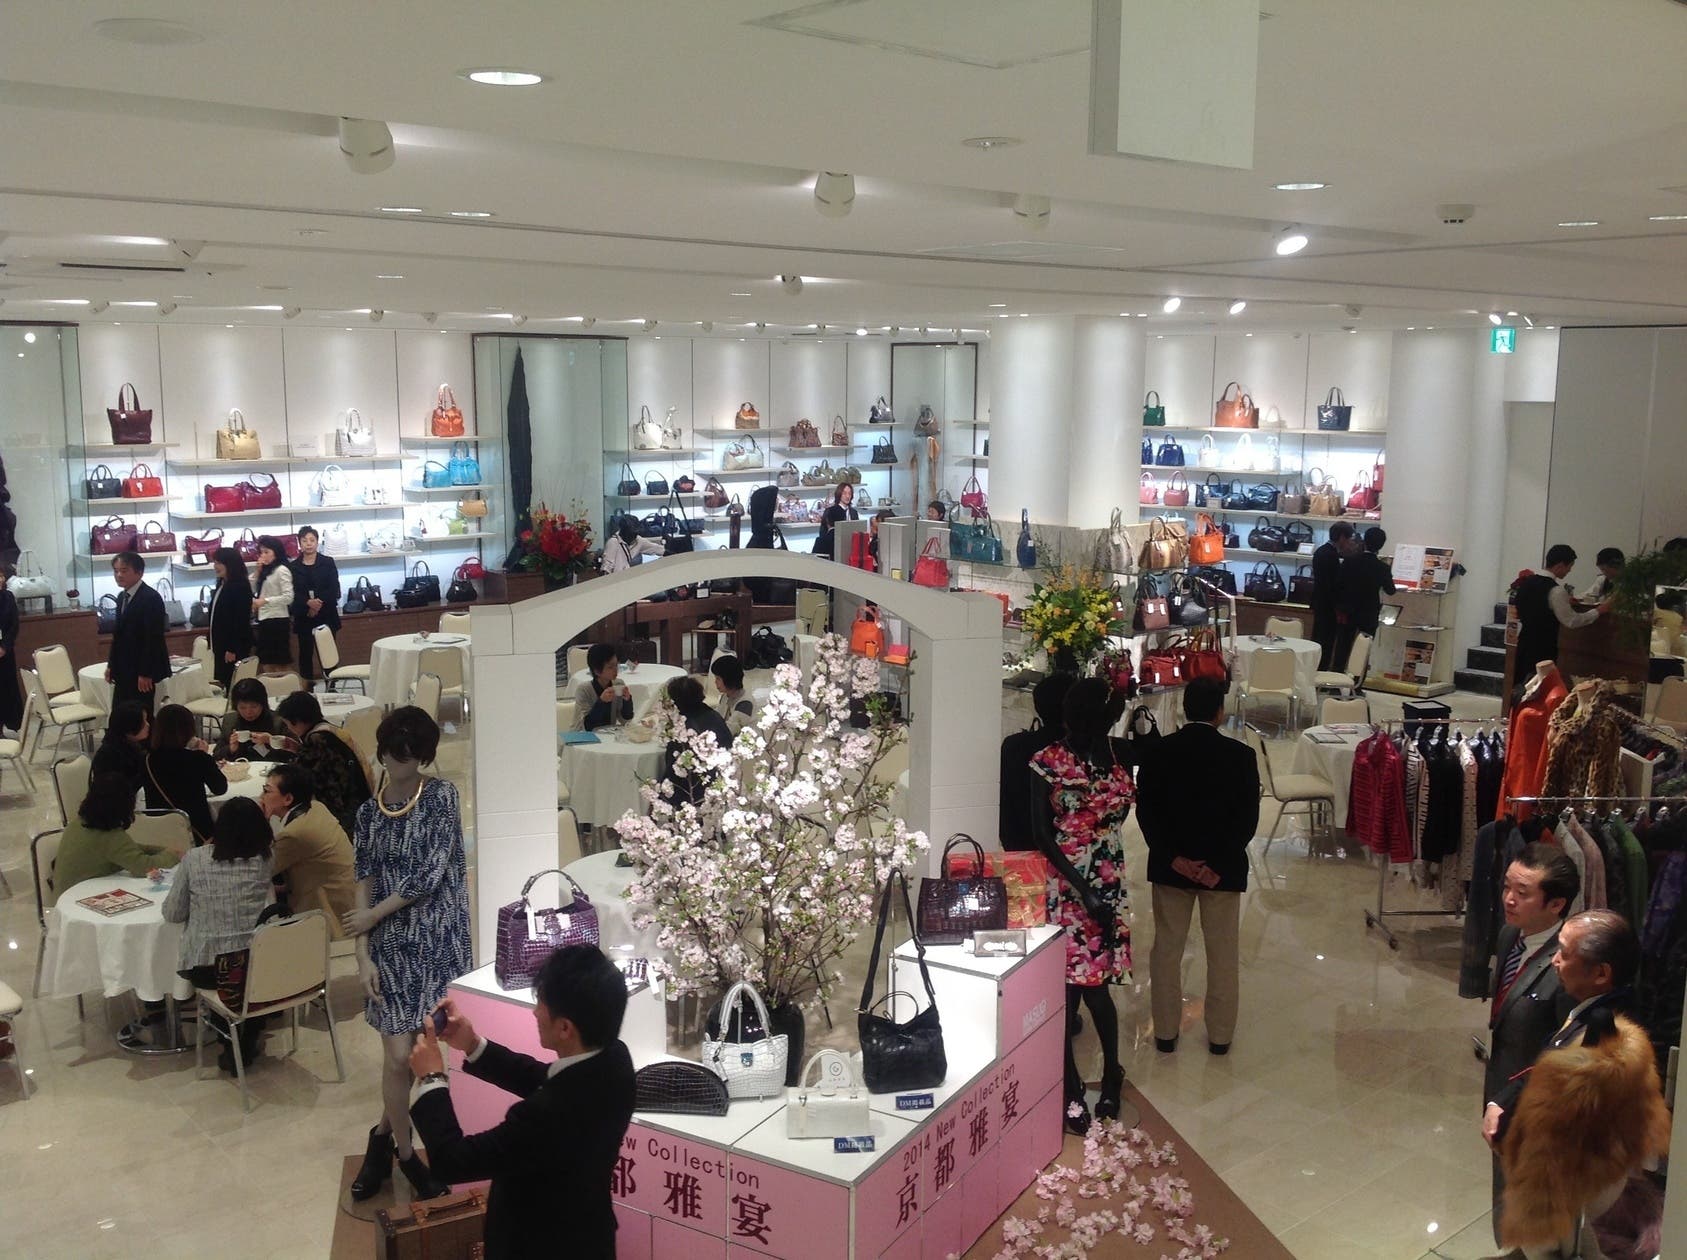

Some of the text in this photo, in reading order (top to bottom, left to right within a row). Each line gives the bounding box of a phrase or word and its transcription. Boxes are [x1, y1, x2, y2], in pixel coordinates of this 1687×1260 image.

[903, 1063, 1015, 1172] 2014 New Collection
[648, 1138, 759, 1189] Collection
